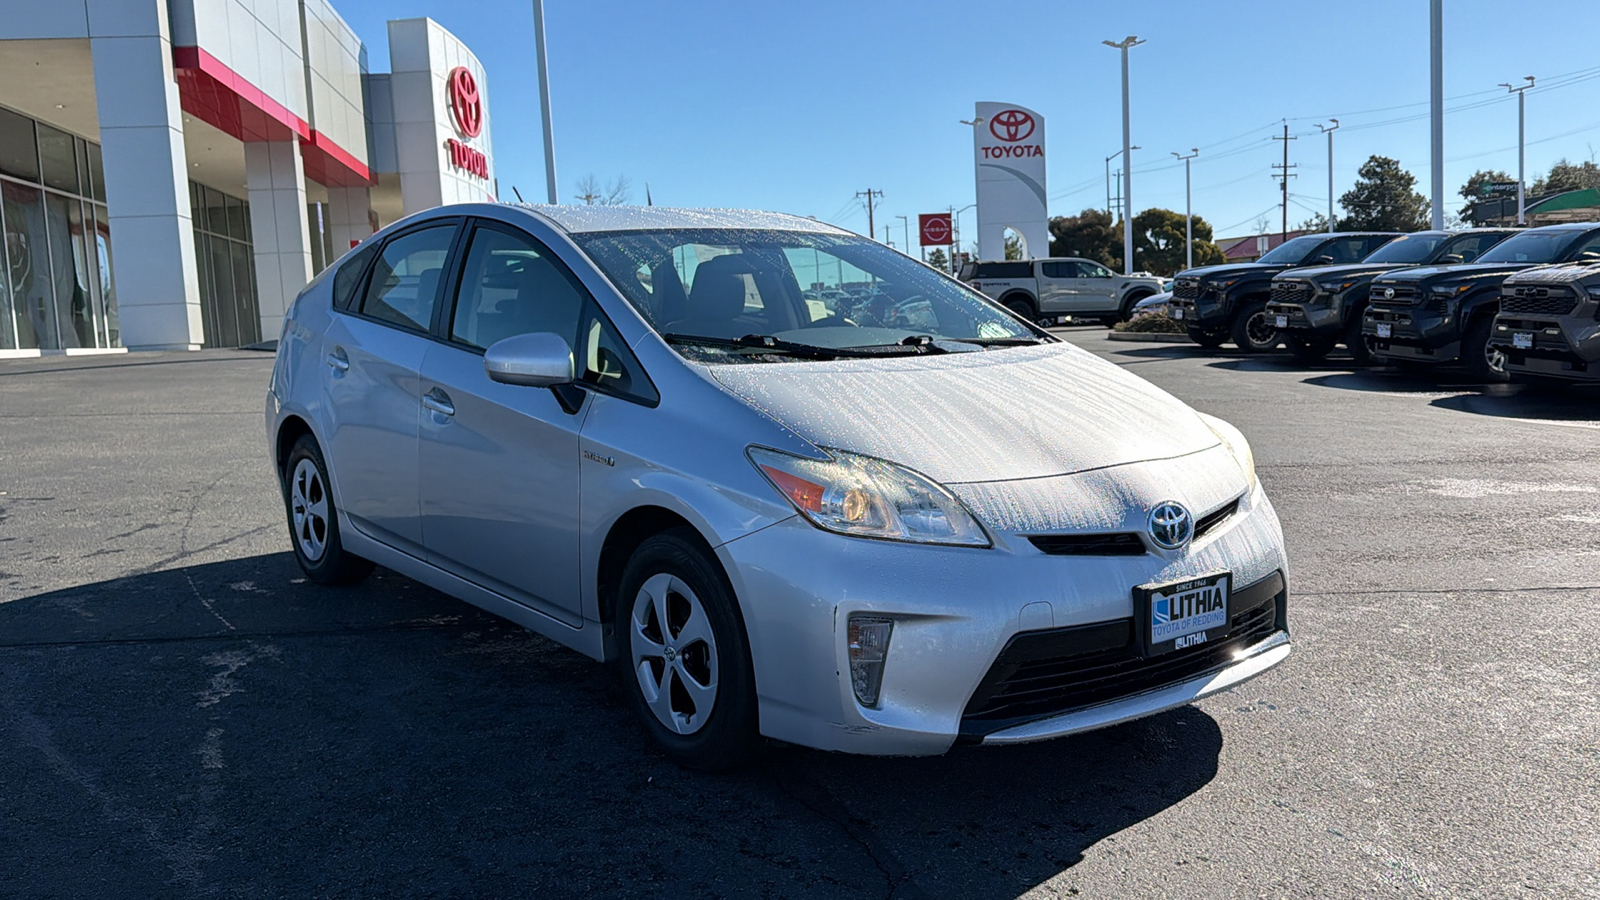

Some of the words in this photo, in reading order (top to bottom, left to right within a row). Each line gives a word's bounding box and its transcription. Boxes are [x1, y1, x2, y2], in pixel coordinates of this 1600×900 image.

[448, 138, 489, 180] TOYOTA
[981, 145, 1044, 159] TOYOTA
[584, 450, 609, 465] HYBRID
[1176, 582, 1193, 592] SINCE
[1194, 579, 1207, 589] 1946
[1169, 587, 1223, 621] LITHIA
[1153, 623, 1180, 637] TOYOTA
[1181, 620, 1191, 630] OF
[1192, 611, 1224, 627] REDDING
[1182, 631, 1207, 648] LITHIA
